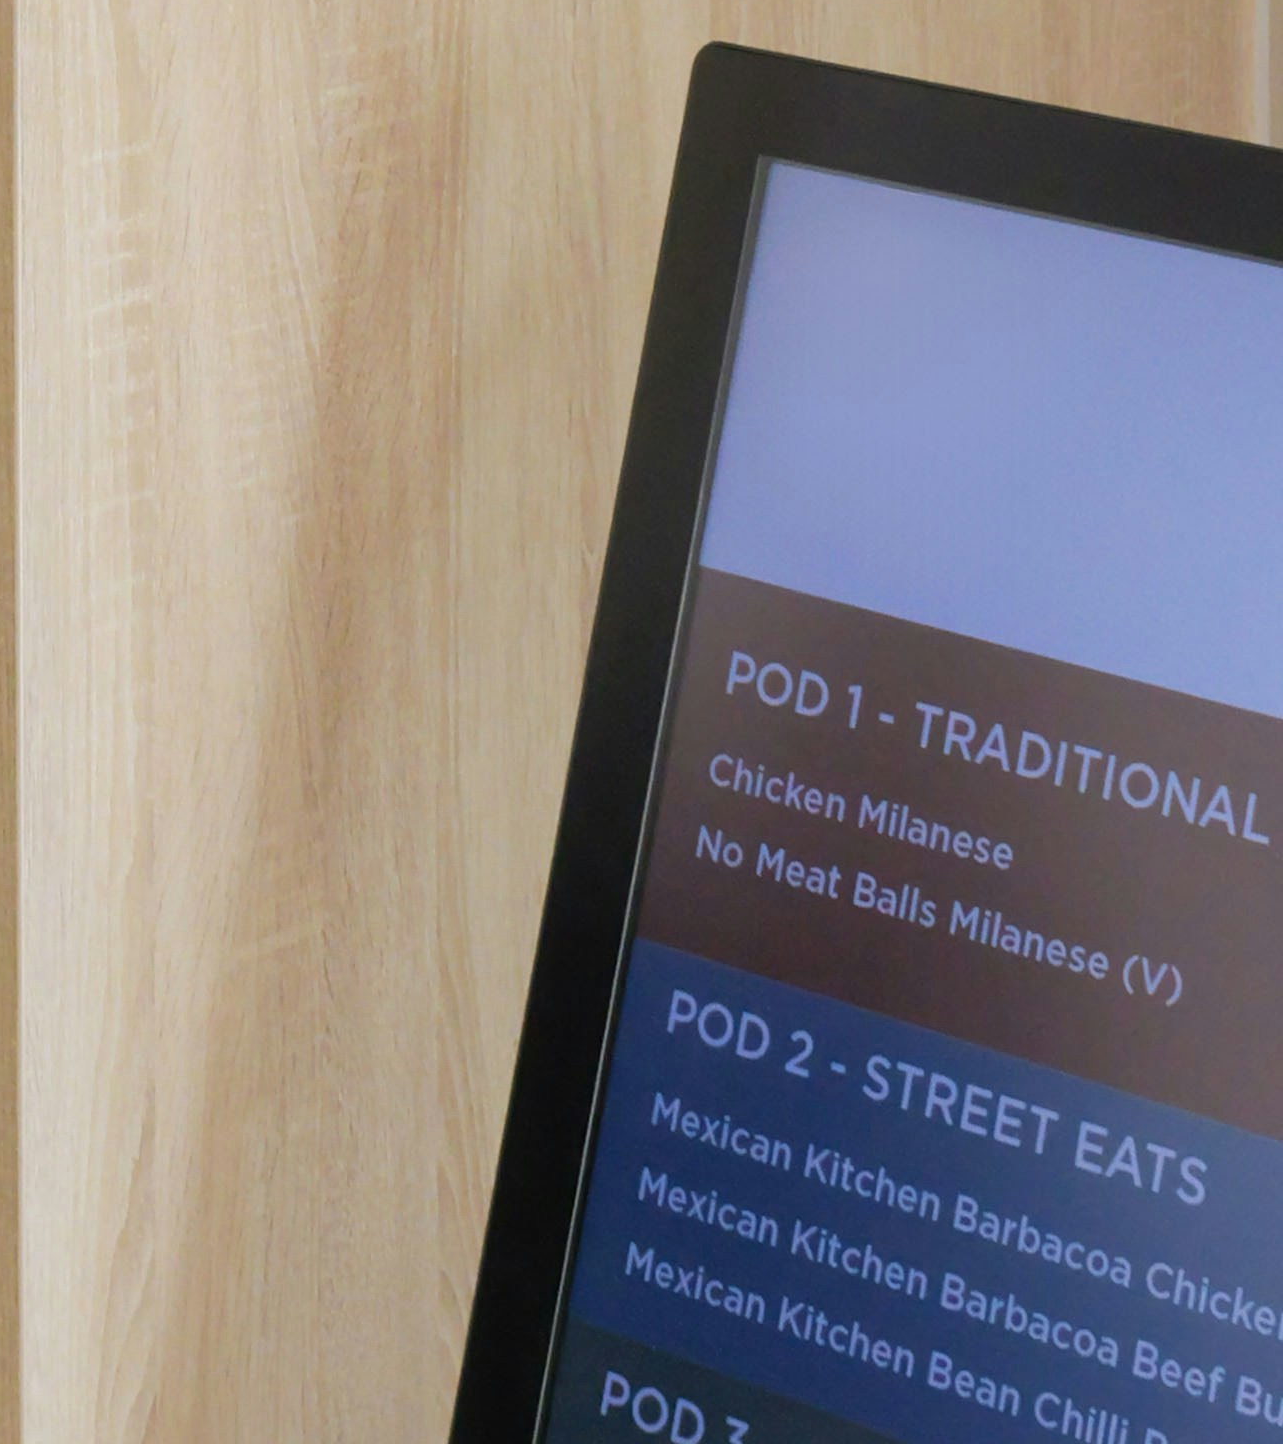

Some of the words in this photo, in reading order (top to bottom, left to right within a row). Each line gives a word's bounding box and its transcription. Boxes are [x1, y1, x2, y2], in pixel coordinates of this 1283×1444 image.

[709, 752, 846, 823] Chicken
[858, 793, 1015, 871] Milanese
[726, 650, 830, 717] POD
[847, 684, 863, 729] 1
[915, 700, 1271, 846] TRADITIONAL
[695, 824, 744, 869] No
[755, 847, 842, 901] Meat
[852, 871, 937, 929] Balls
[949, 899, 1110, 980] Milanese
[1122, 953, 1184, 1008] (V)
[667, 988, 771, 1062] POD
[784, 1029, 815, 1079] 2
[861, 1054, 1060, 1158] STREET
[1073, 1121, 1210, 1208] EATS
[638, 1167, 780, 1248] Mexican
[790, 1218, 928, 1303] Kitchen
[939, 1272, 1120, 1370] Barbacoa
[1132, 1340, 1228, 1404] Beef
[1235, 1375, 1283, 1428] Bu
[650, 1091, 793, 1173] Mexican
[803, 1143, 941, 1224] Kitchen
[952, 1193, 1133, 1291] Barbacoa
[1145, 1261, 1283, 1342] Chicke
[599, 1370, 706, 1444] POD
[624, 1241, 767, 1325] Mexican
[777, 1295, 916, 1380] Kitchen
[926, 1350, 1023, 1418] Bean
[1034, 1392, 1133, 1444] Chilli
